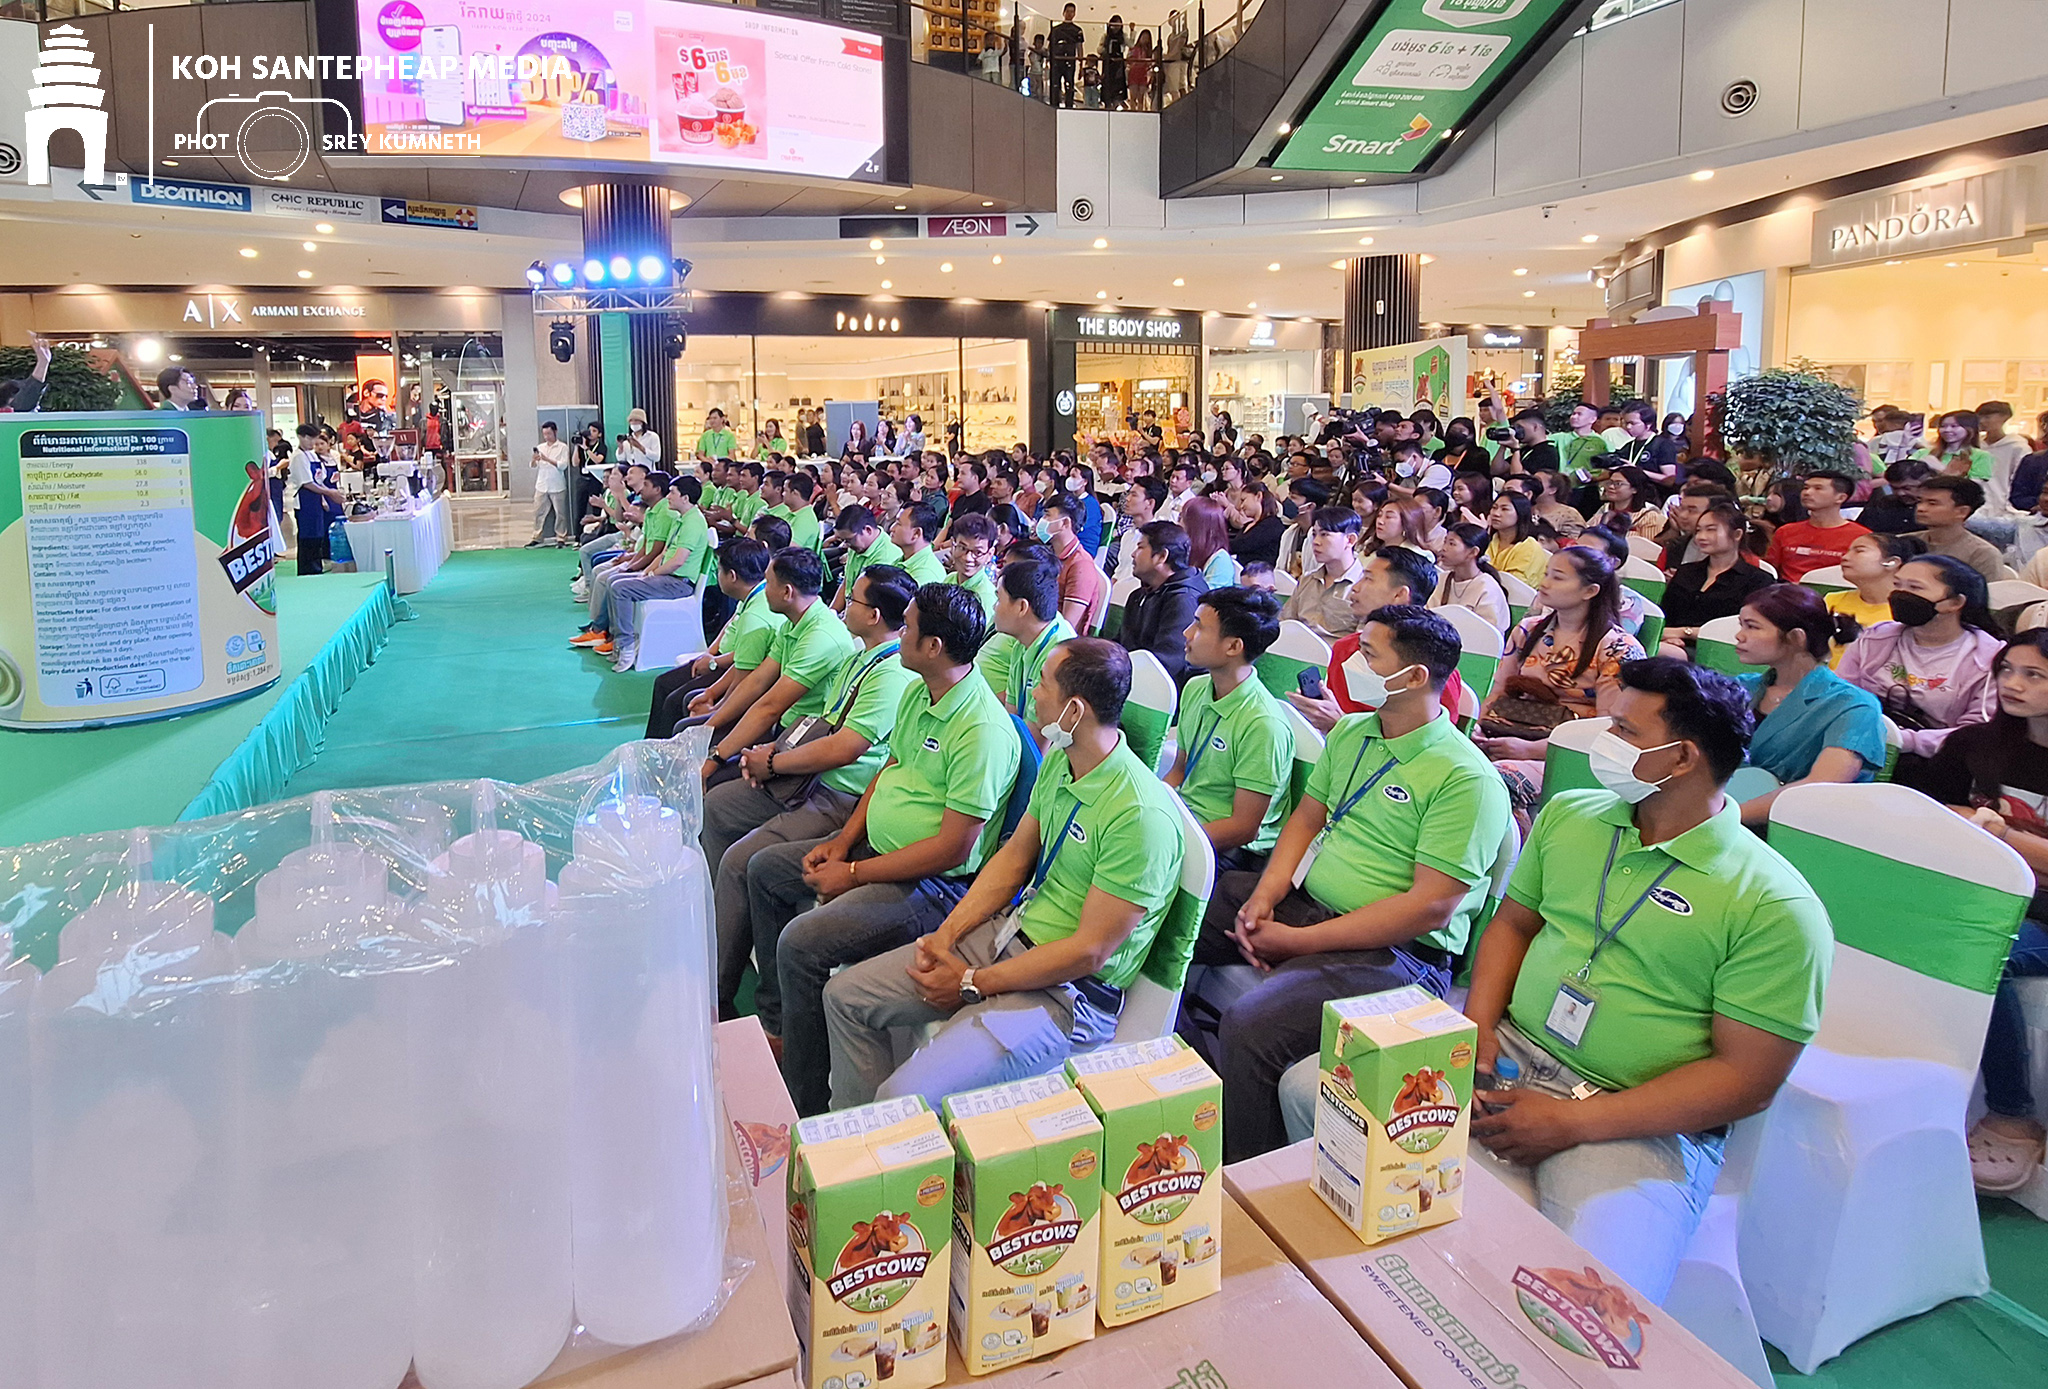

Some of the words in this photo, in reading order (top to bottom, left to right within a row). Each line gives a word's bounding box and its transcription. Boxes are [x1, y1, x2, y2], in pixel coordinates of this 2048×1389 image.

[526, 13, 550, 22] 2024
[745, 22, 760, 30] SHOP
[762, 23, 798, 36] INFORMATION
[774, 51, 800, 62] Special
[802, 53, 816, 62] Offer
[818, 57, 836, 67] From
[838, 60, 851, 70] Cold
[1322, 134, 1403, 155] Smart
[866, 160, 879, 174] 2F
[140, 184, 243, 206] DECATHLON
[271, 193, 302, 204] CHIC
[307, 196, 364, 210] REPUBLIC
[252, 306, 298, 316] ARMANI
[303, 306, 366, 316] EXCHANGE
[1078, 317, 1104, 335] THE
[1108, 319, 1144, 337] BODY
[64, 470, 104, 480] Carbohydrate
[92, 542, 122, 550] vegetable
[134, 540, 150, 548] whey
[152, 538, 176, 546] powder,
[96, 548, 130, 556] stabilizers,
[227, 538, 274, 583] BEST
[151, 600, 184, 609] preparation
[91, 662, 128, 672] Production
[1322, 1086, 1365, 1128] BESTCOWS
[1387, 1109, 1457, 1138] BESTCOWS
[1119, 1174, 1203, 1210] BESTCOWS
[989, 1224, 1078, 1262] BESTCOWS
[830, 1256, 927, 1296] BESTCOWS
[1361, 1264, 1435, 1338] SWEETENED
[1516, 1270, 1628, 1368] BESTCOWS
